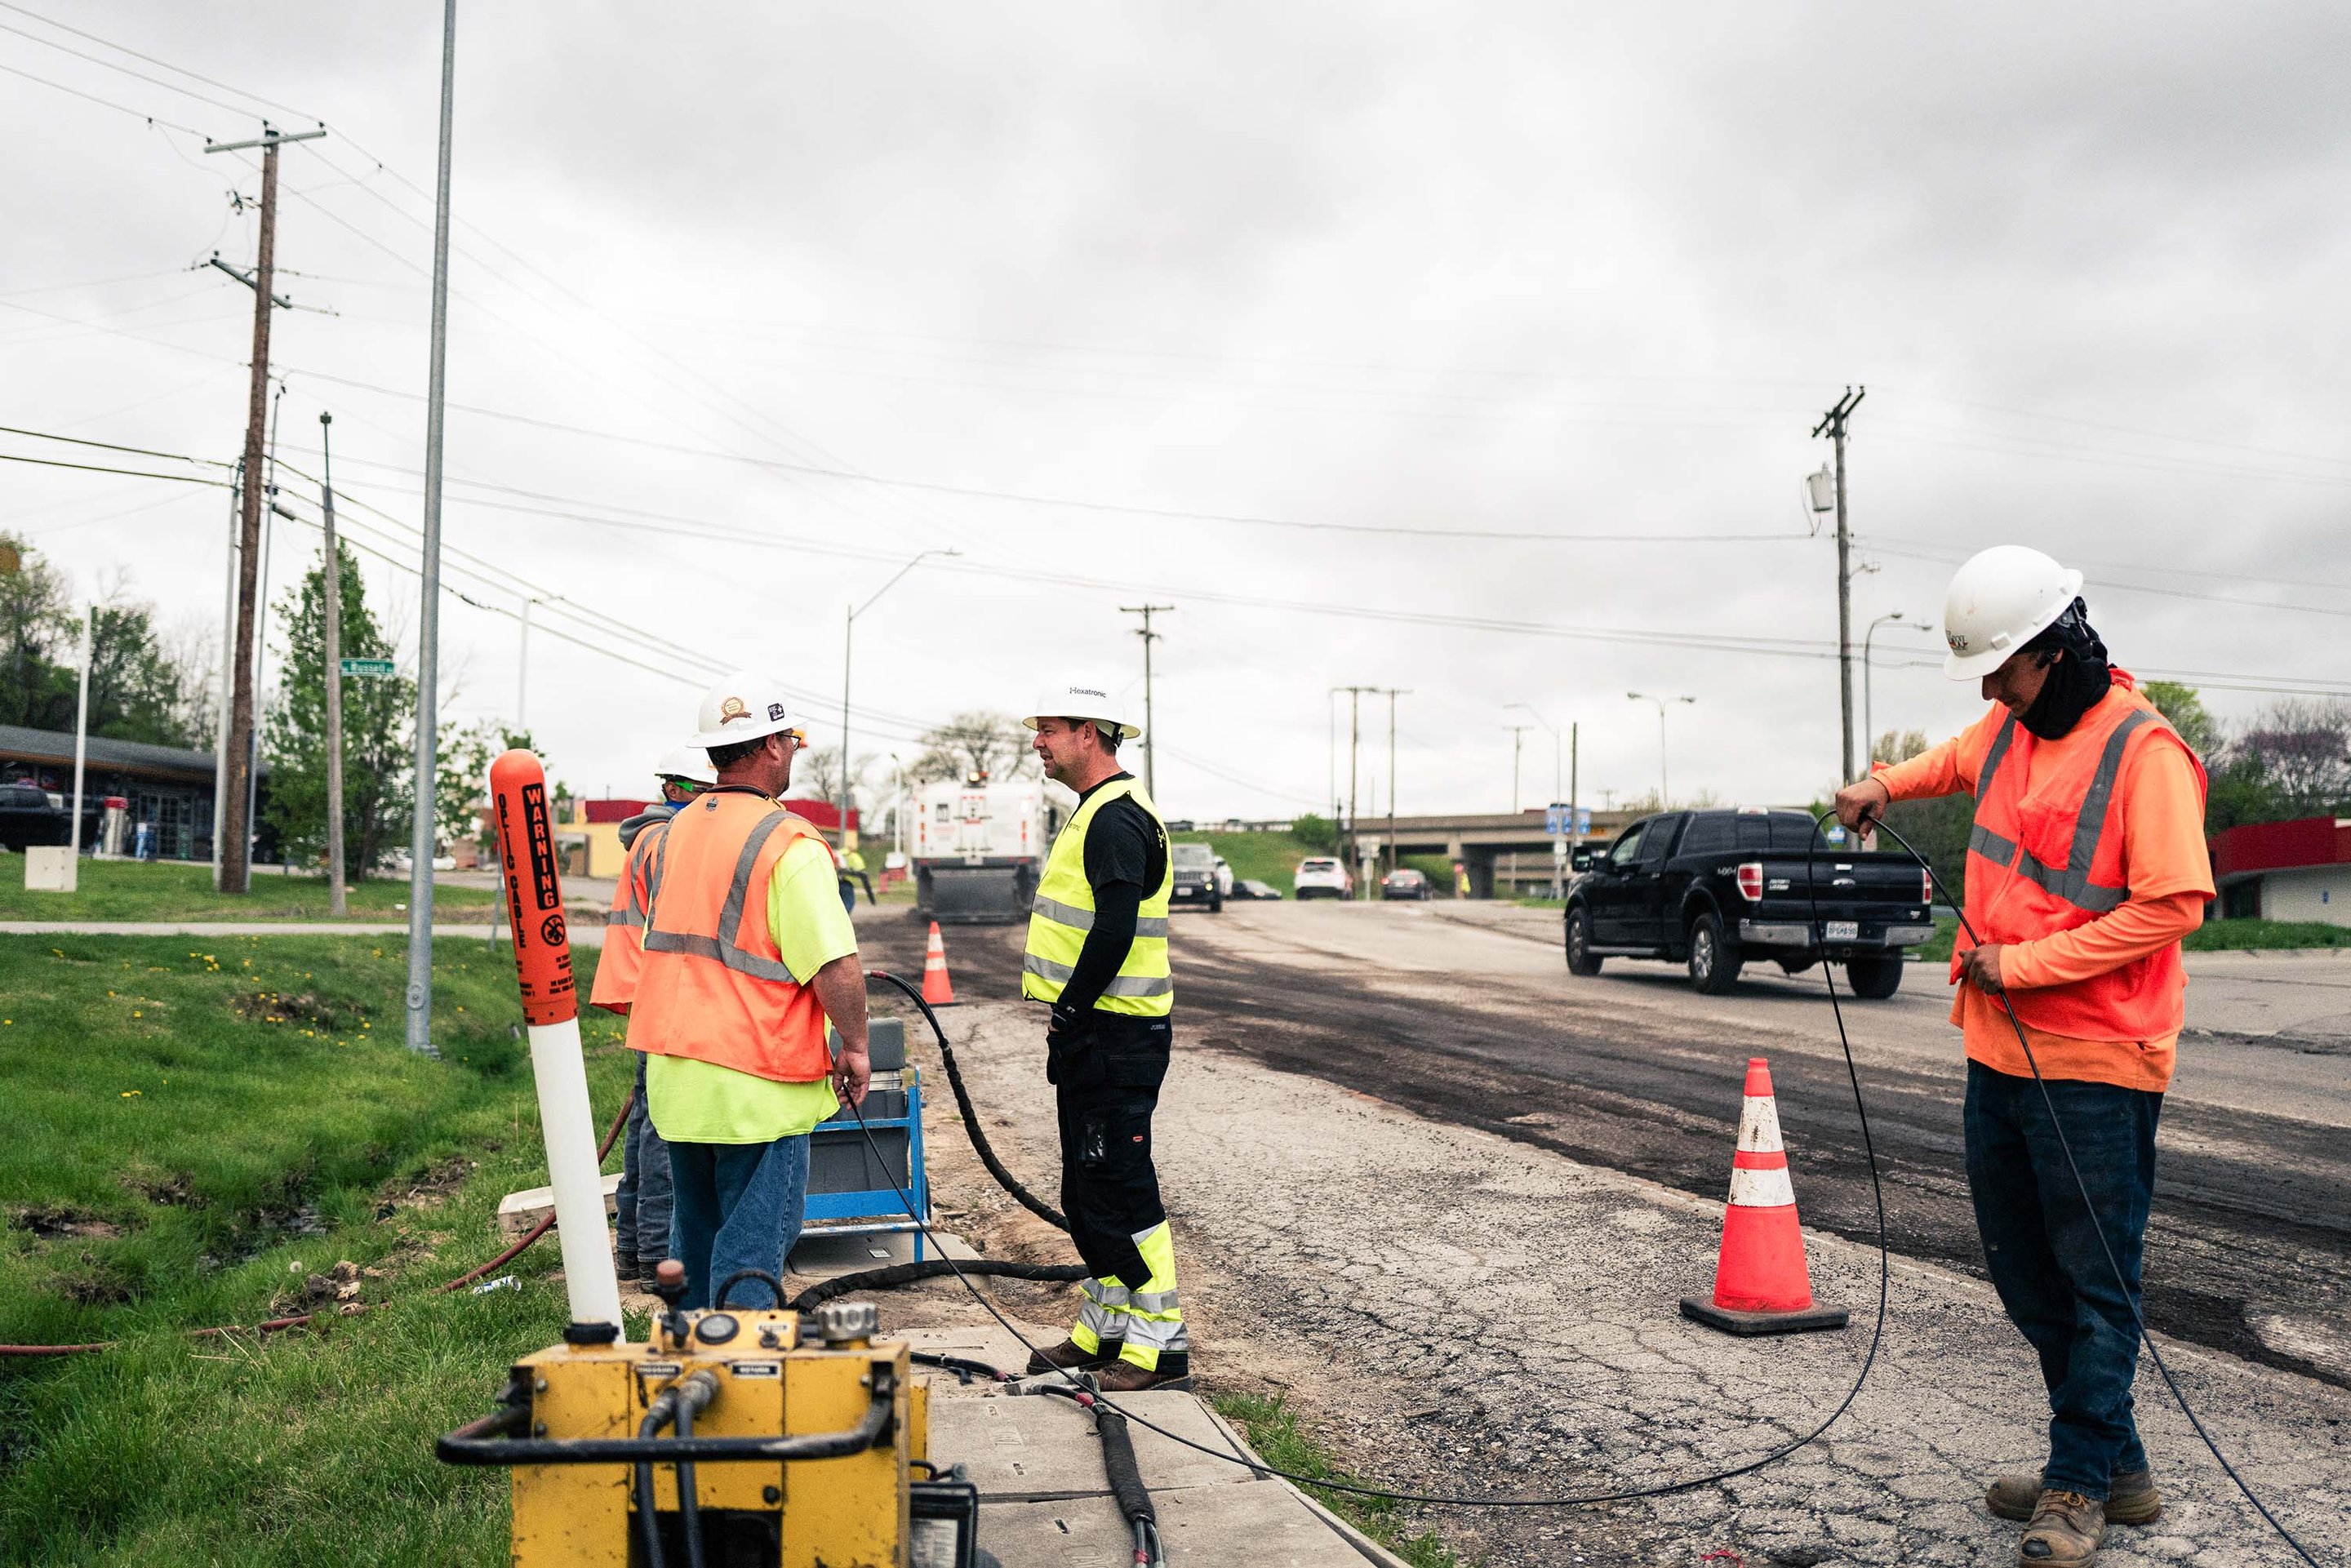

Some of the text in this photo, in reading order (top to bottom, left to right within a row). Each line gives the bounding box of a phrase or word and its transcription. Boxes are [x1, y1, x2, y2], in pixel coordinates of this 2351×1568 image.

[1069, 686, 1107, 698] Hexatronic
[498, 793, 527, 948] OPTIC CABLE
[527, 788, 555, 908] WARNING
